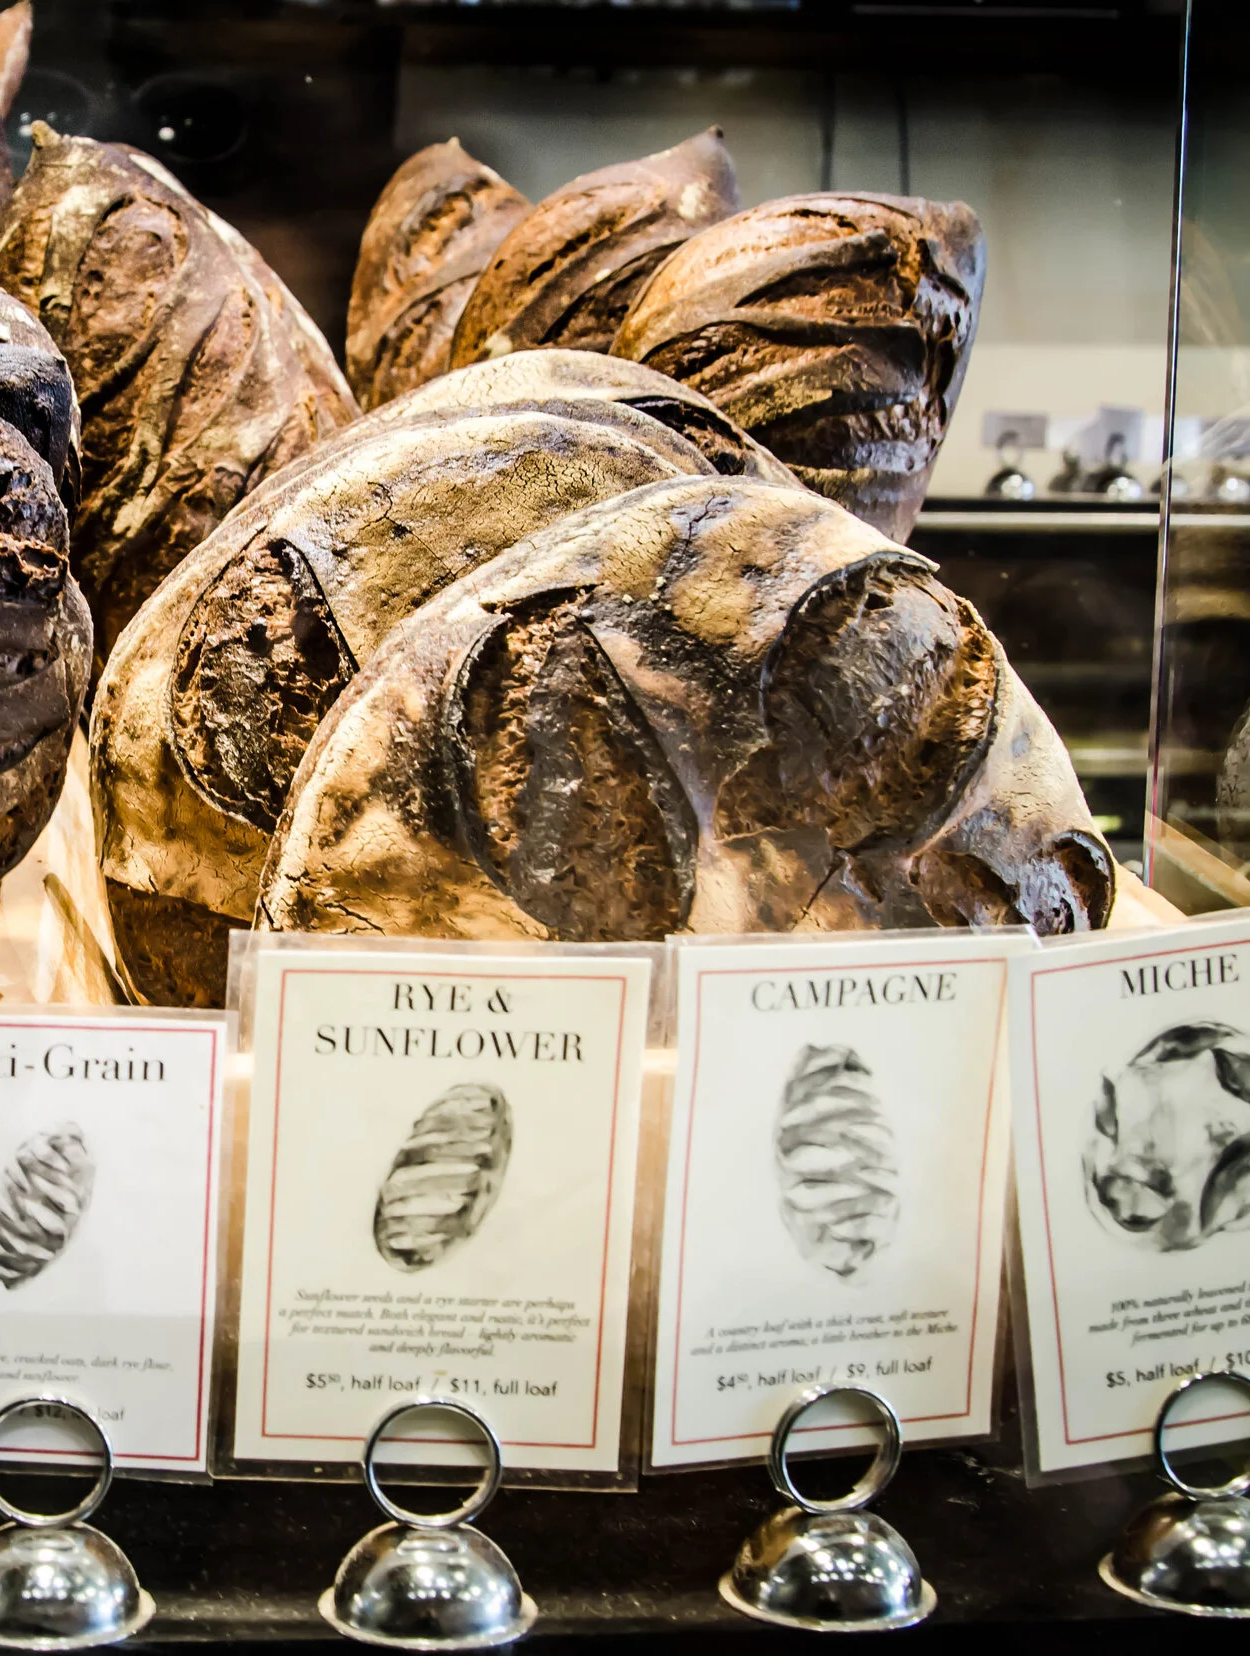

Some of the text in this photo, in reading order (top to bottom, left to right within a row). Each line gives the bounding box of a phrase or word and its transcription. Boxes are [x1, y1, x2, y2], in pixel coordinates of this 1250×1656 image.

[1120, 954, 1239, 999] MICHE
[393, 982, 512, 1013] RYE &
[750, 972, 957, 1013] CAMPAGNE
[314, 1024, 584, 1062] SUNFLOWER
[350, 1375, 383, 1390] half
[388, 1376, 419, 1391] loaf
[493, 1380, 519, 1395] full
[525, 1381, 556, 1396] loaf
[758, 1369, 786, 1386] half
[791, 1366, 821, 1383] loaf
[876, 1359, 898, 1376] full
[903, 1356, 931, 1373] loaf
[1136, 1363, 1164, 1381] half
